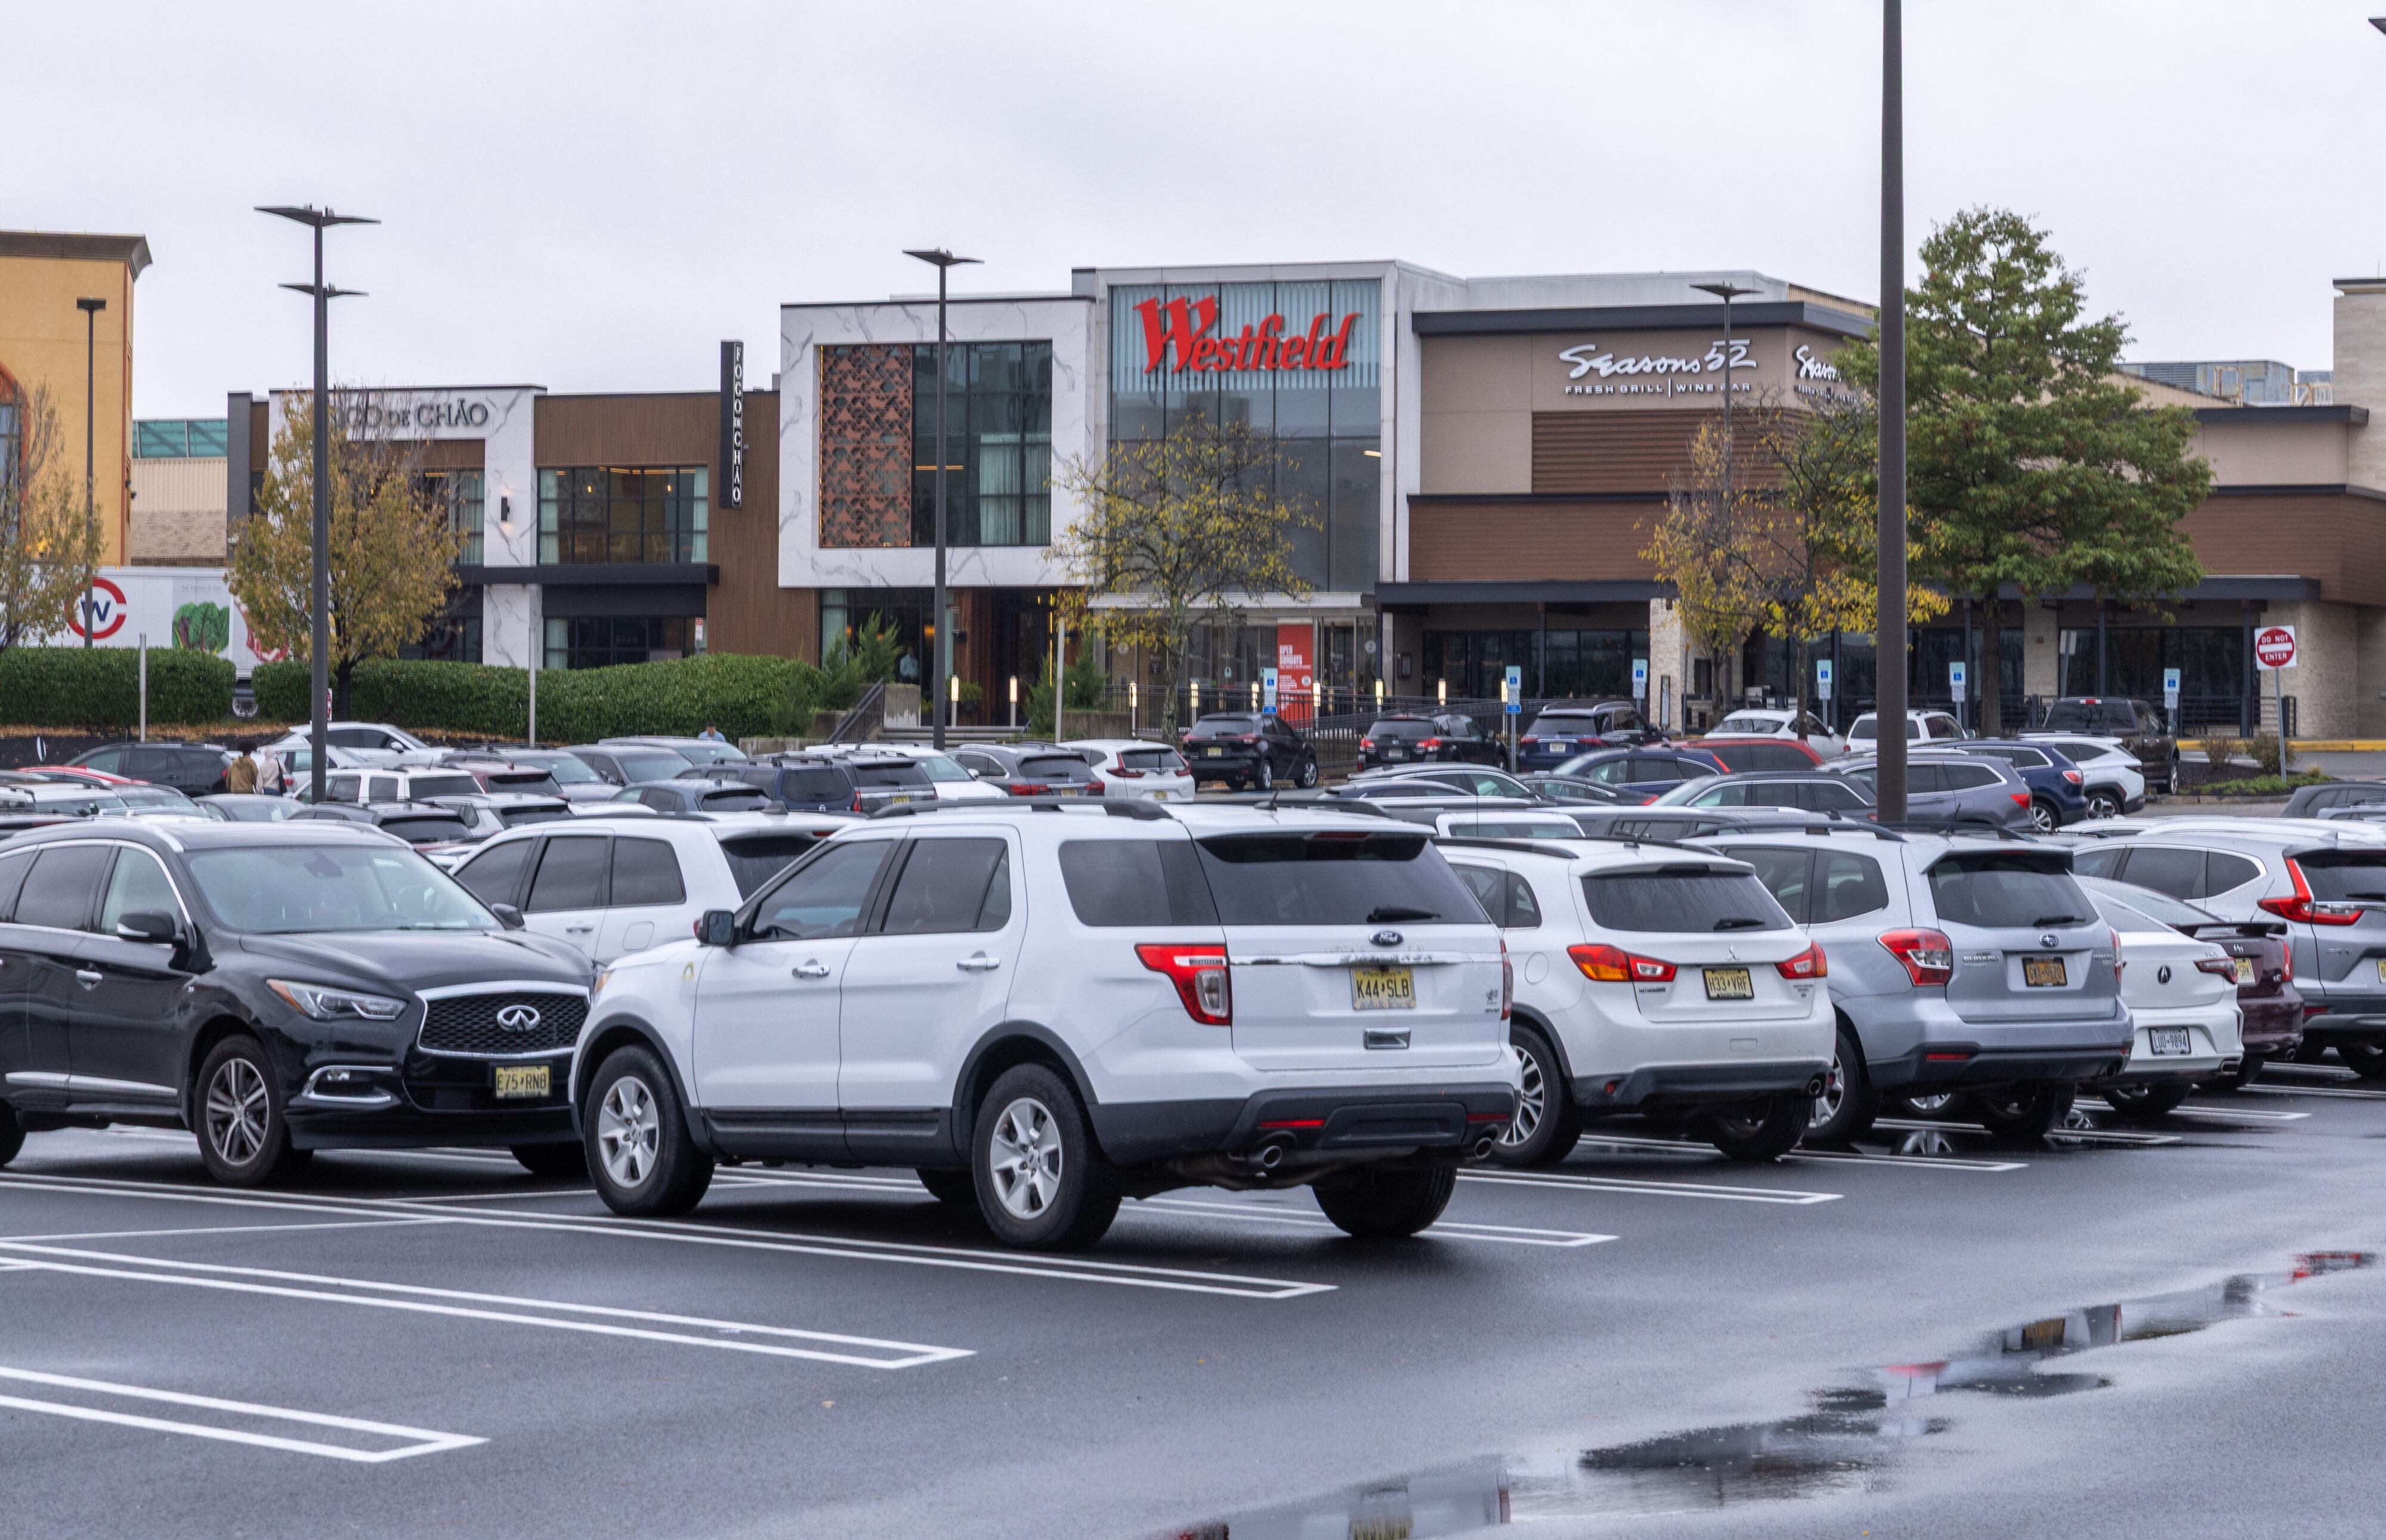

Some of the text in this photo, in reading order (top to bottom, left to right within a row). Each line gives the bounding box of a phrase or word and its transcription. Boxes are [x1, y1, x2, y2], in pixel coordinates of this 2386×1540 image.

[1133, 295, 1362, 374] Westfield
[1559, 339, 1757, 379] Seasons 52
[734, 346, 743, 414] FOGO
[1565, 385, 1614, 395] FRESH
[1620, 384, 1663, 394] GRILL
[1676, 384, 1714, 393] WINE
[418, 398, 489, 428] CHÃO
[734, 417, 741, 428] DE
[733, 431, 741, 502] CHÃO
[2261, 634, 2288, 644] DO NOT
[1279, 645, 1293, 655] OPEN
[1279, 655, 1303, 665] SUNDAYS
[2265, 653, 2287, 661] ENTER
